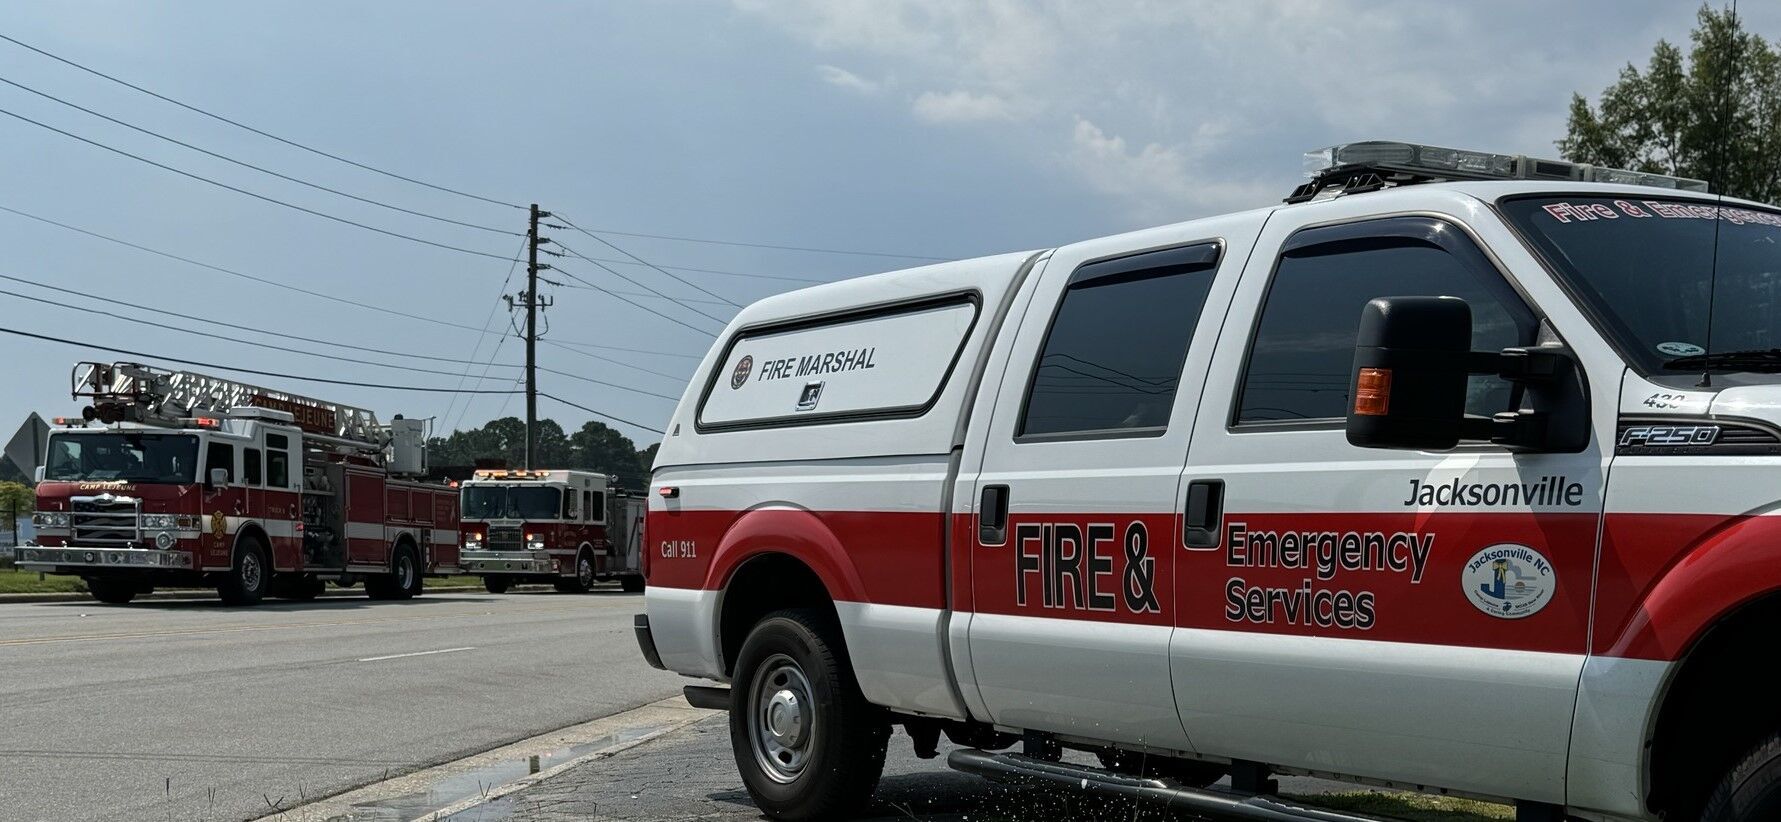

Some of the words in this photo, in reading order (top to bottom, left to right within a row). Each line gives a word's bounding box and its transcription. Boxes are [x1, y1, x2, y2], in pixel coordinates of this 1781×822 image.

[1542, 202, 1619, 223] Fire
[1614, 200, 1653, 218] &
[758, 357, 797, 381] FIRE
[795, 347, 875, 377] MARSHAL
[1643, 393, 1685, 409] 430
[1619, 425, 1721, 447] F-250
[1404, 475, 1583, 506] Jacksonville
[661, 540, 678, 558] Call
[680, 540, 697, 558] 911
[1226, 522, 1435, 583] Emergency
[1469, 549, 1533, 573] Jacksonville
[1534, 558, 1550, 576] NC
[1016, 523, 1116, 612] FIRE
[1123, 520, 1161, 613] &
[1225, 577, 1376, 630] Services
